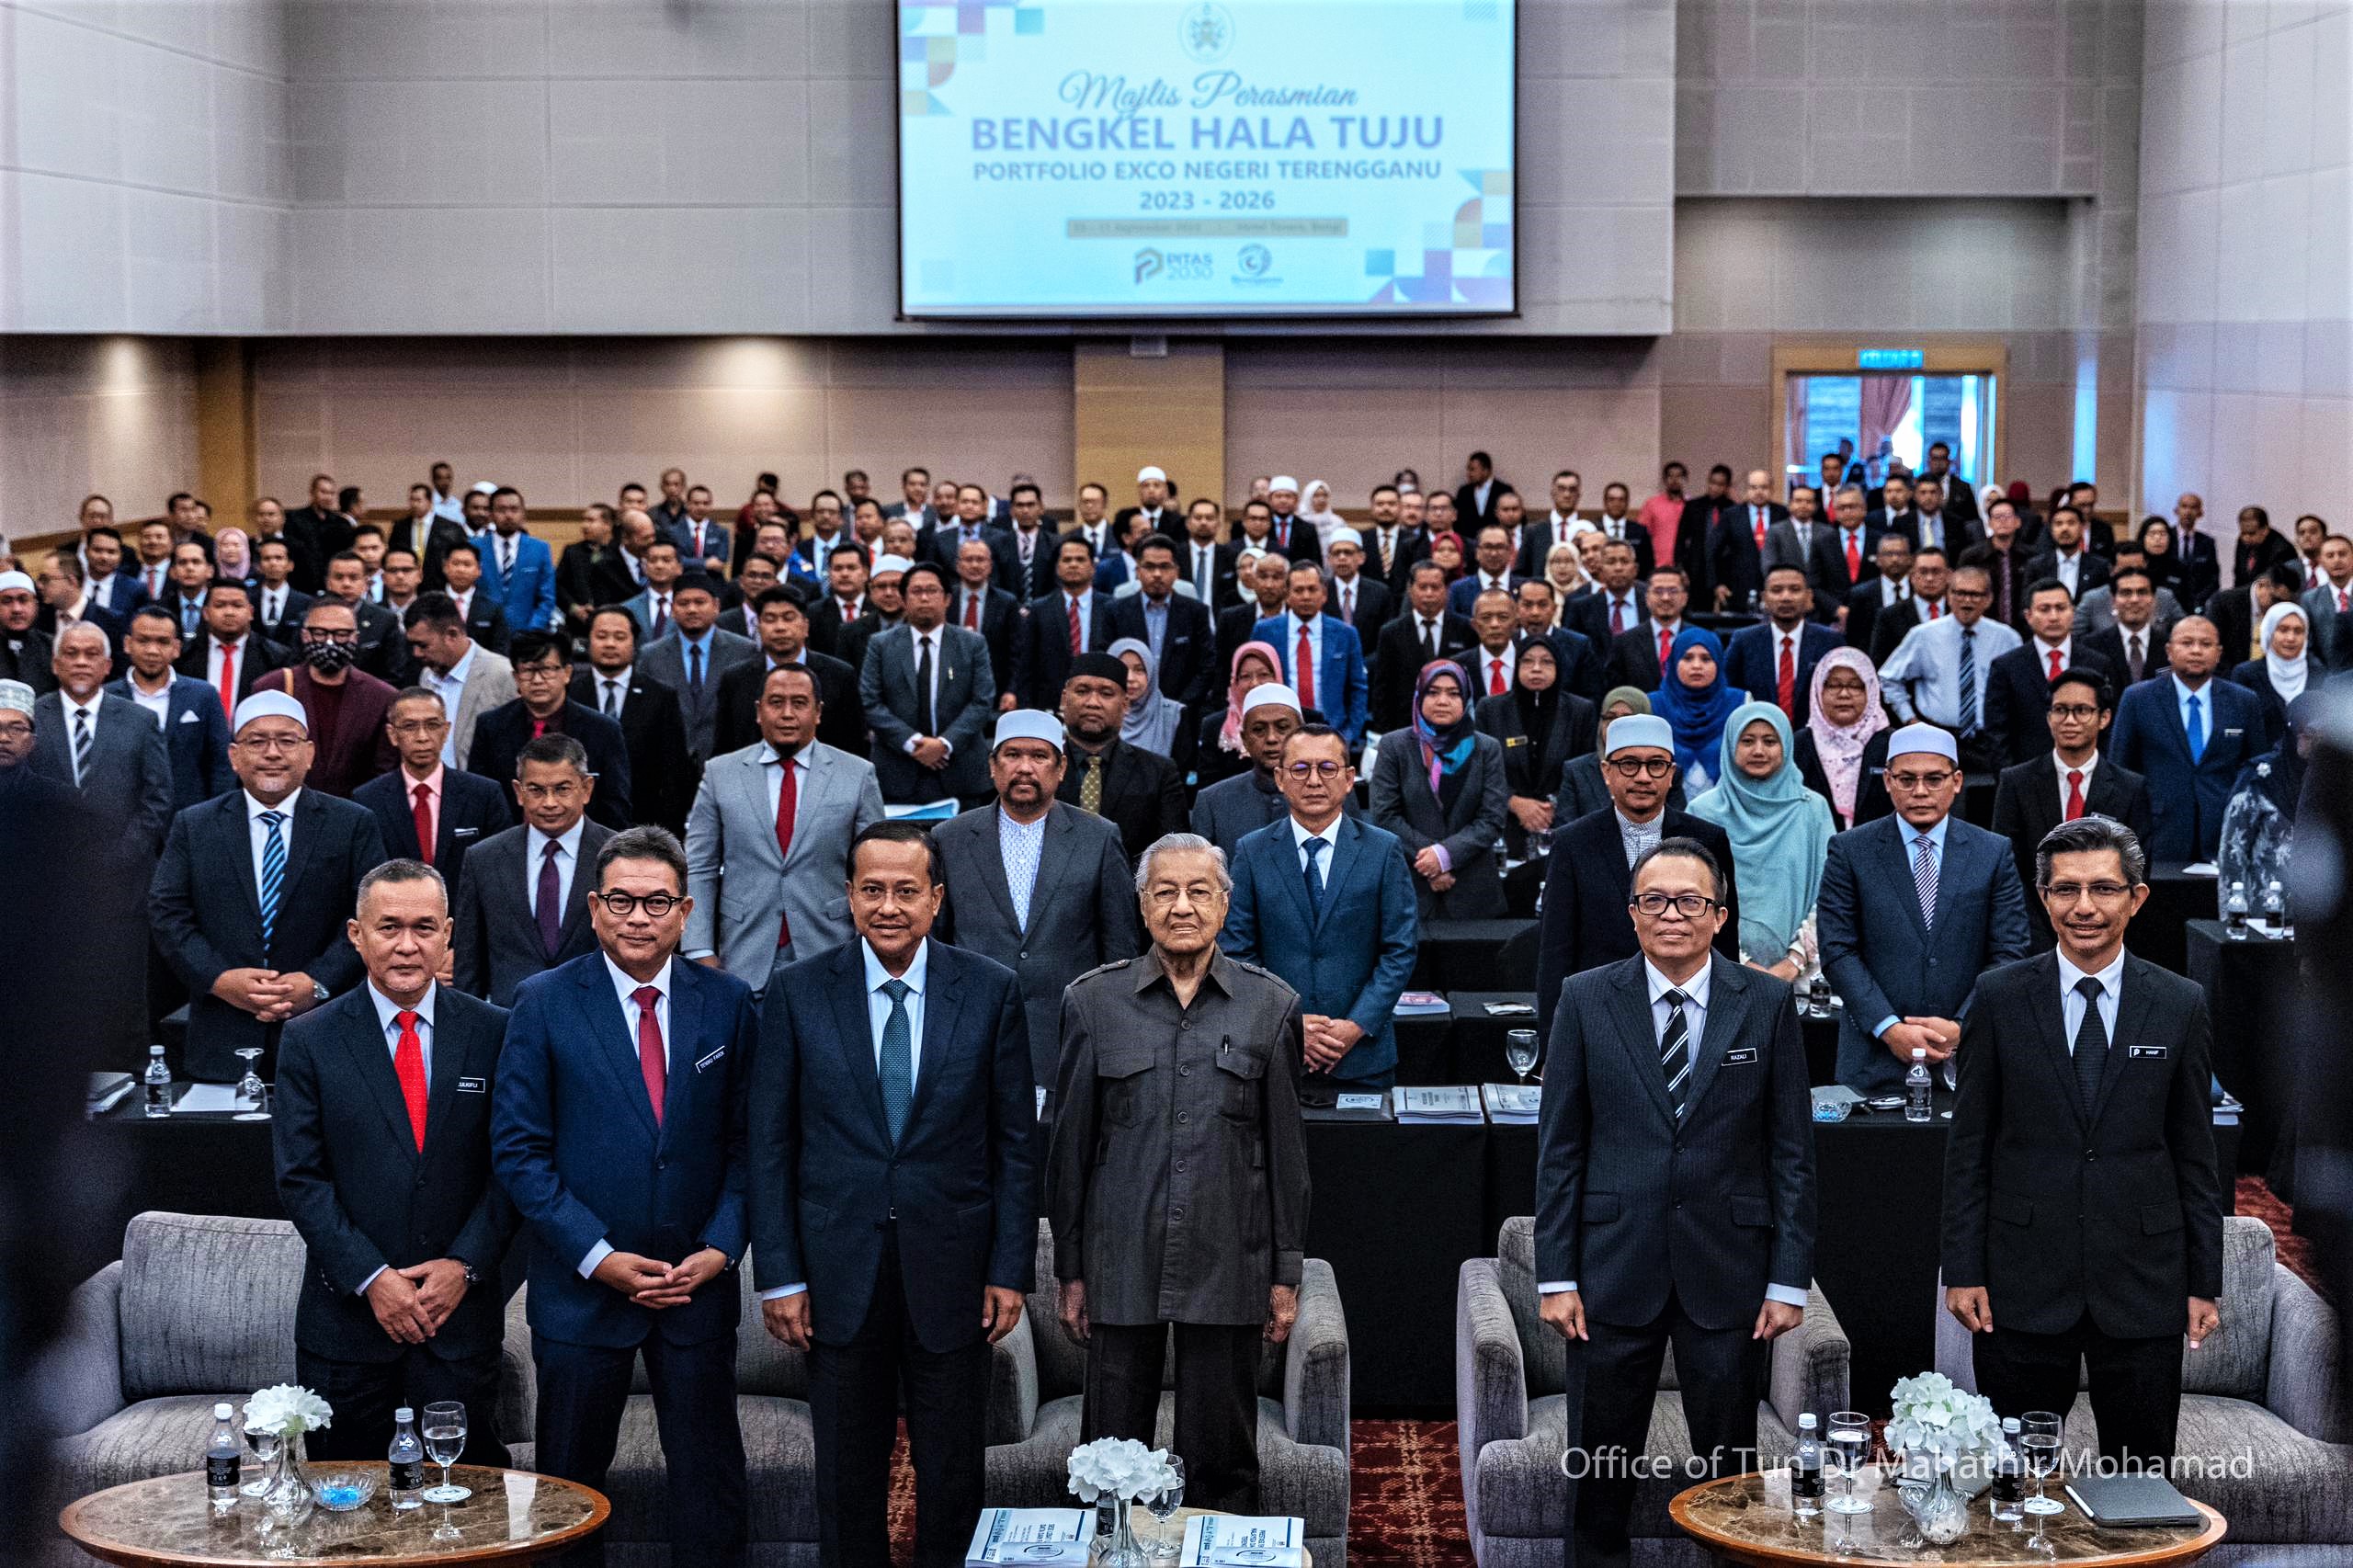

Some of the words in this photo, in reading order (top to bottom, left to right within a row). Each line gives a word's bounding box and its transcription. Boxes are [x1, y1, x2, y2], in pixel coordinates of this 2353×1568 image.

[1058, 69, 1182, 120] Majlis
[1190, 70, 1359, 109] Perasmian
[972, 117, 1176, 151] BENGKEL
[1191, 116, 1316, 150] HALA
[1329, 115, 1443, 150] TUJU
[973, 160, 1106, 182] PORTFOLIO
[1115, 160, 1176, 181] EXCO
[1184, 159, 1269, 181] NEGERI
[1279, 158, 1442, 180] TERENGGANU
[1139, 190, 1195, 210] 2023
[1219, 189, 1276, 210] 2026
